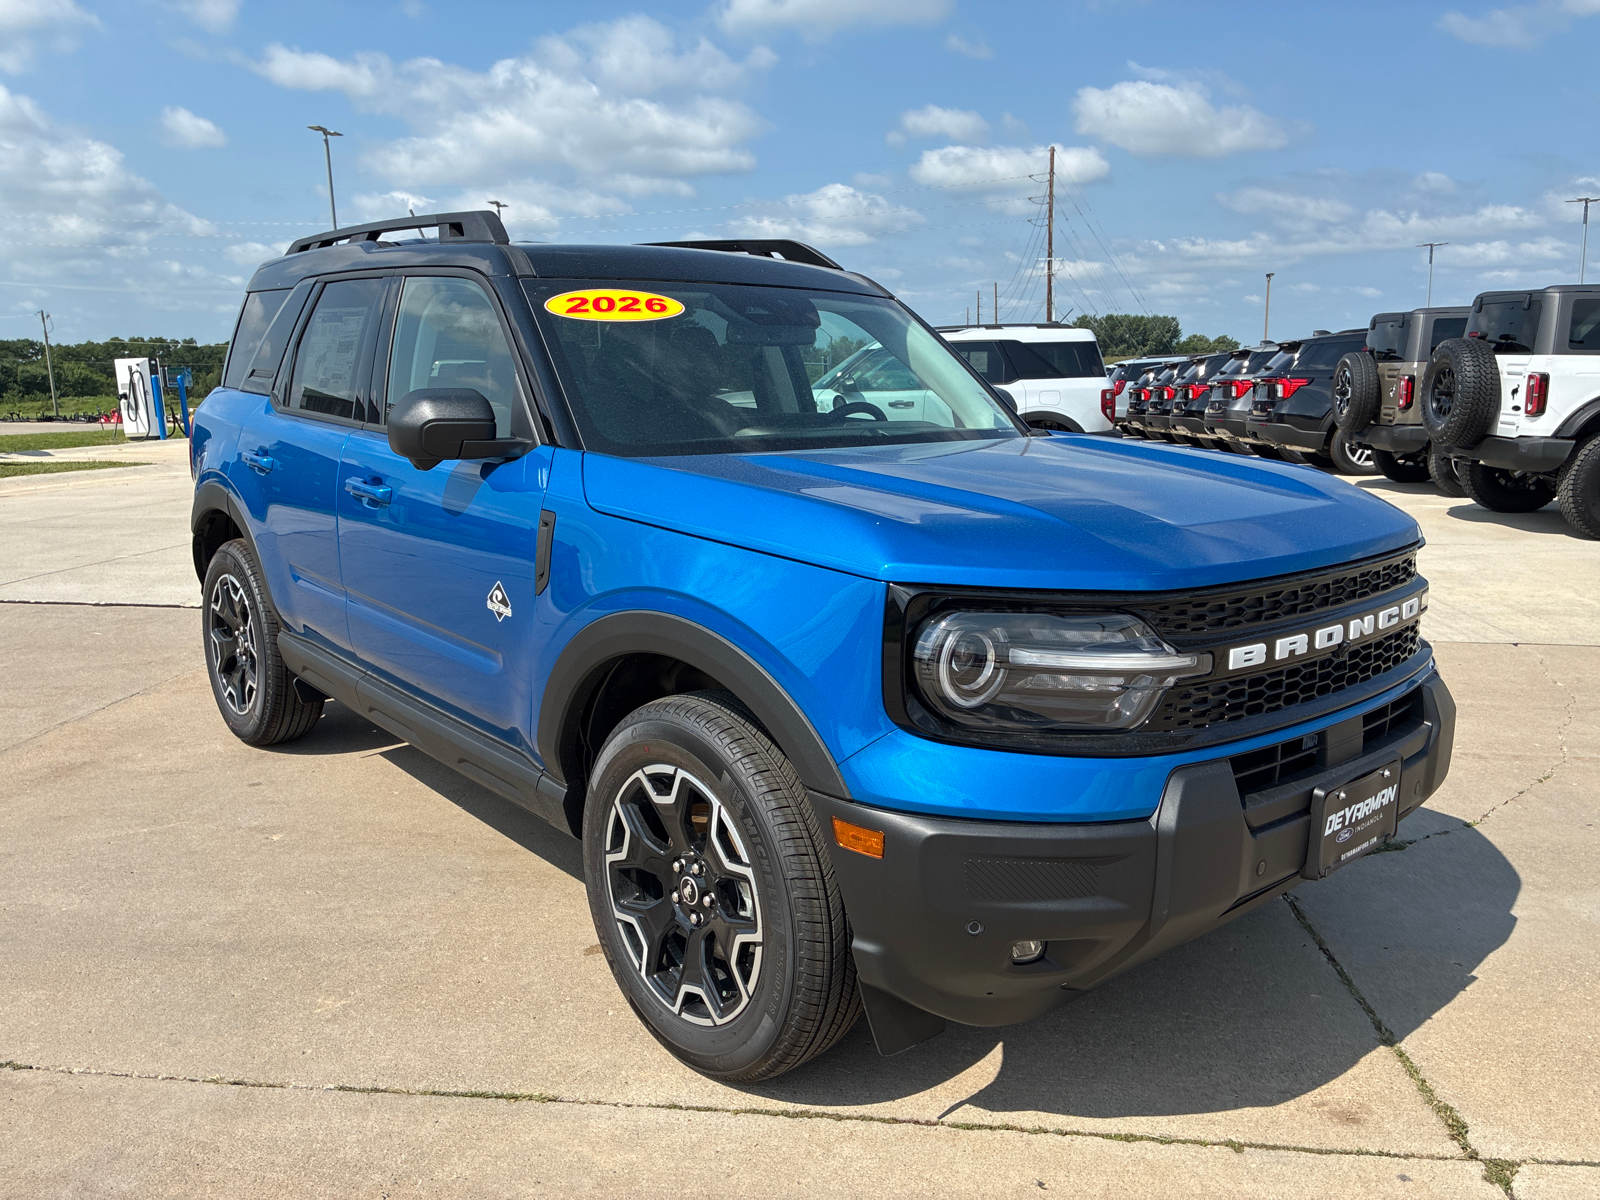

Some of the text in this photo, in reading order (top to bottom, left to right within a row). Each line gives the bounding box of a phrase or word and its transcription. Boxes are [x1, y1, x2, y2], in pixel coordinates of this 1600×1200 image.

[565, 296, 669, 313] 2026
[1228, 597, 1420, 671] BRONCO
[1324, 783, 1398, 837] DEYARMAN
[1355, 813, 1383, 833] INDIANOLA
[1337, 829, 1353, 842] Ford
[742, 817, 782, 924] MICHELIN
